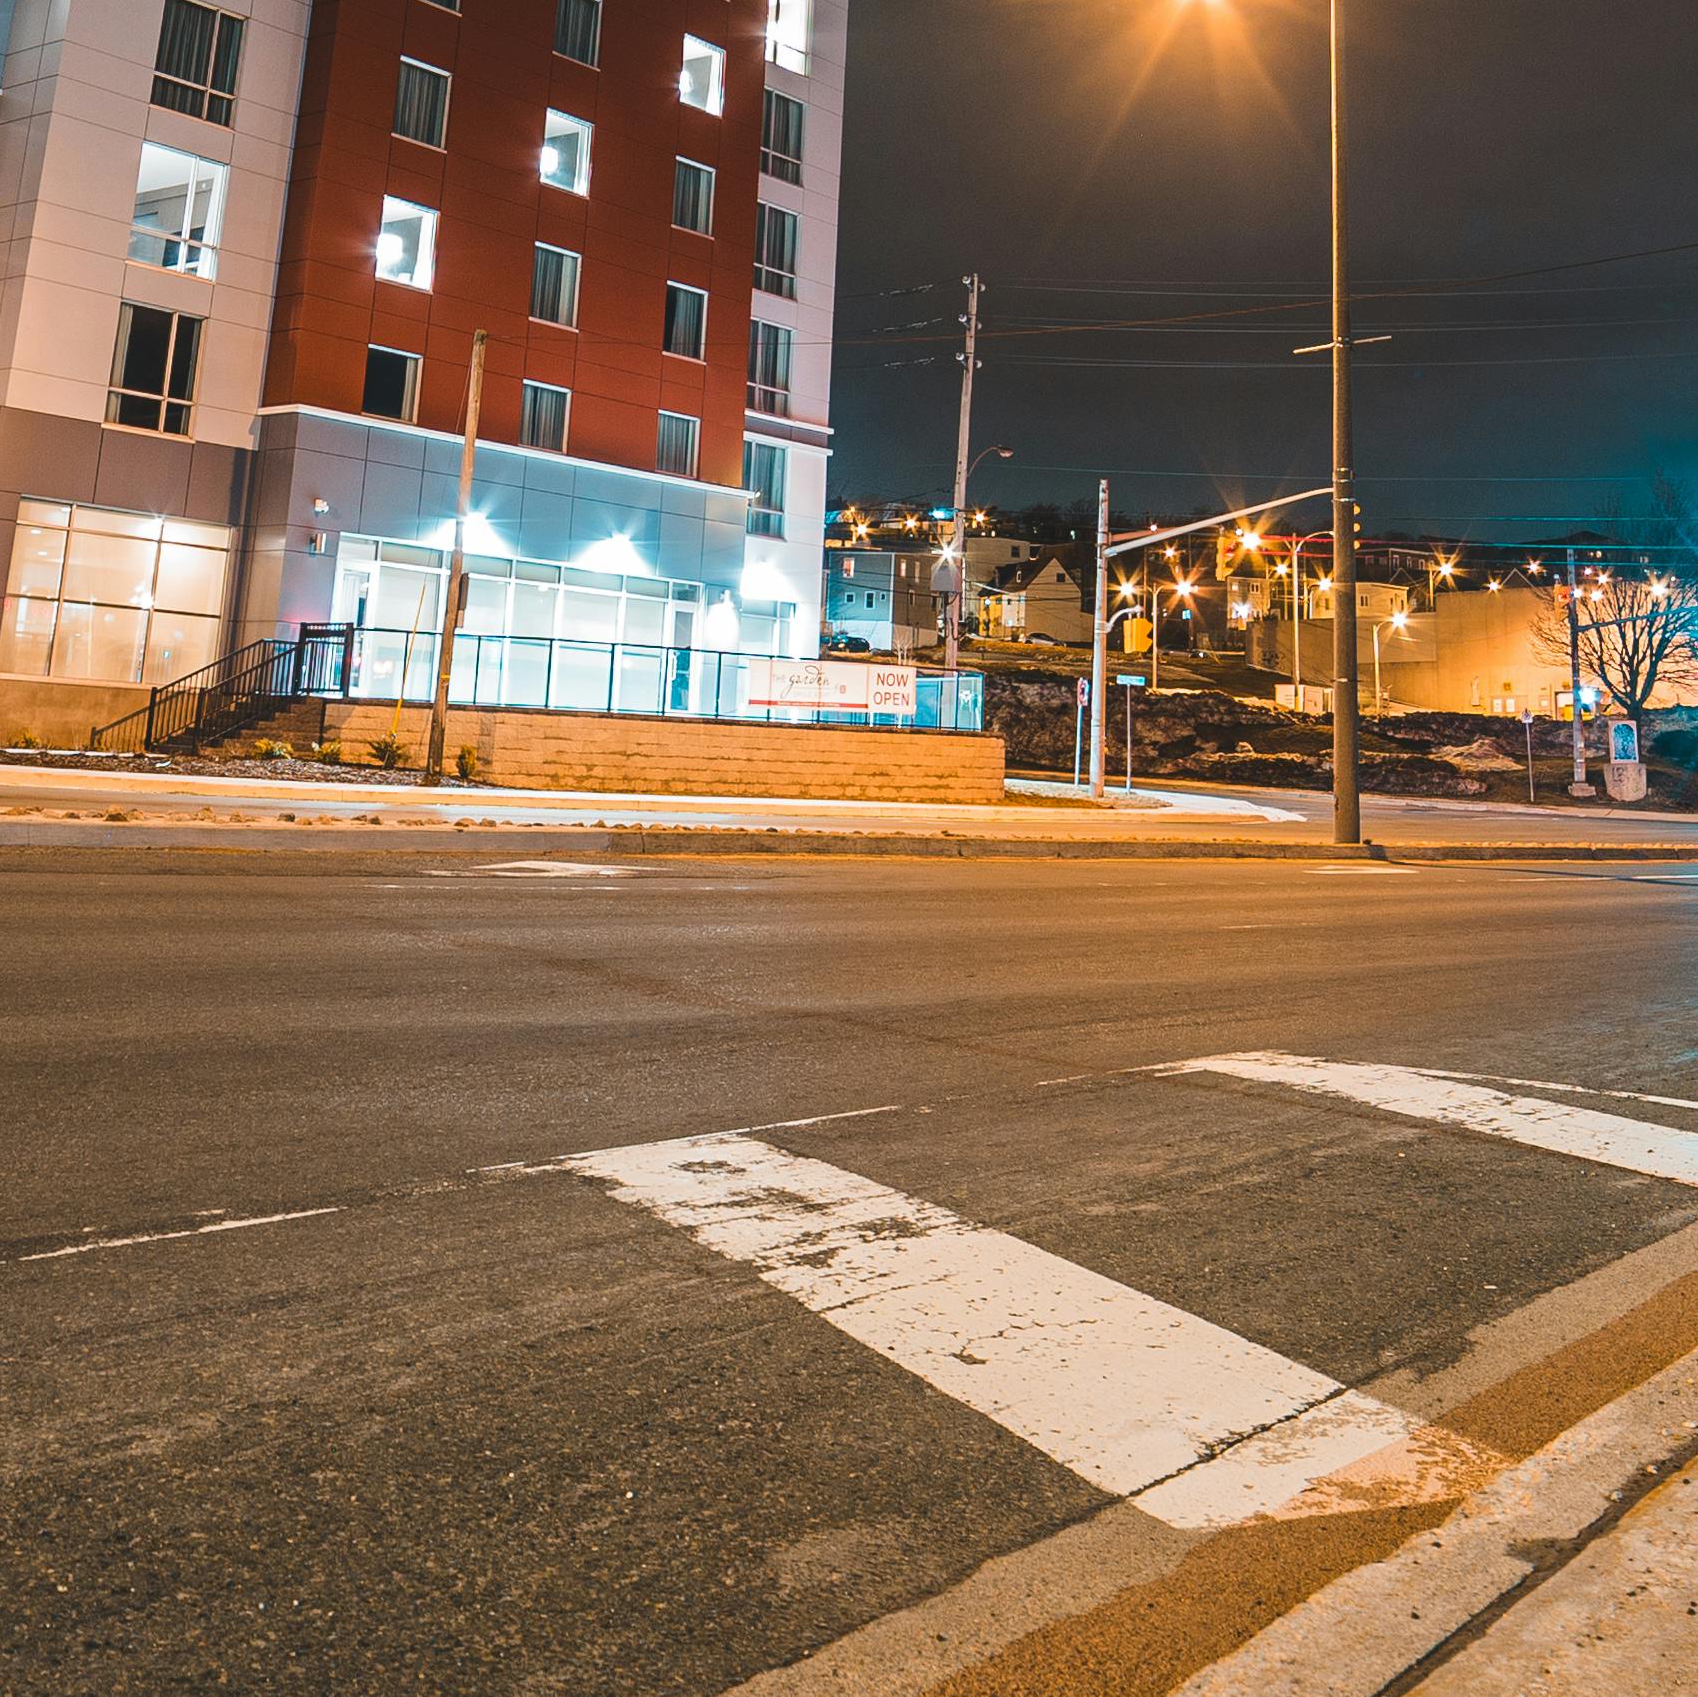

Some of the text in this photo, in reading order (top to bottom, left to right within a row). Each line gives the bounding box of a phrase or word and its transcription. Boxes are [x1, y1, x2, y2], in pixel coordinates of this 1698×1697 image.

[780, 665, 831, 699] garden
[876, 673, 908, 687] NOW
[873, 691, 910, 706] OPEN
